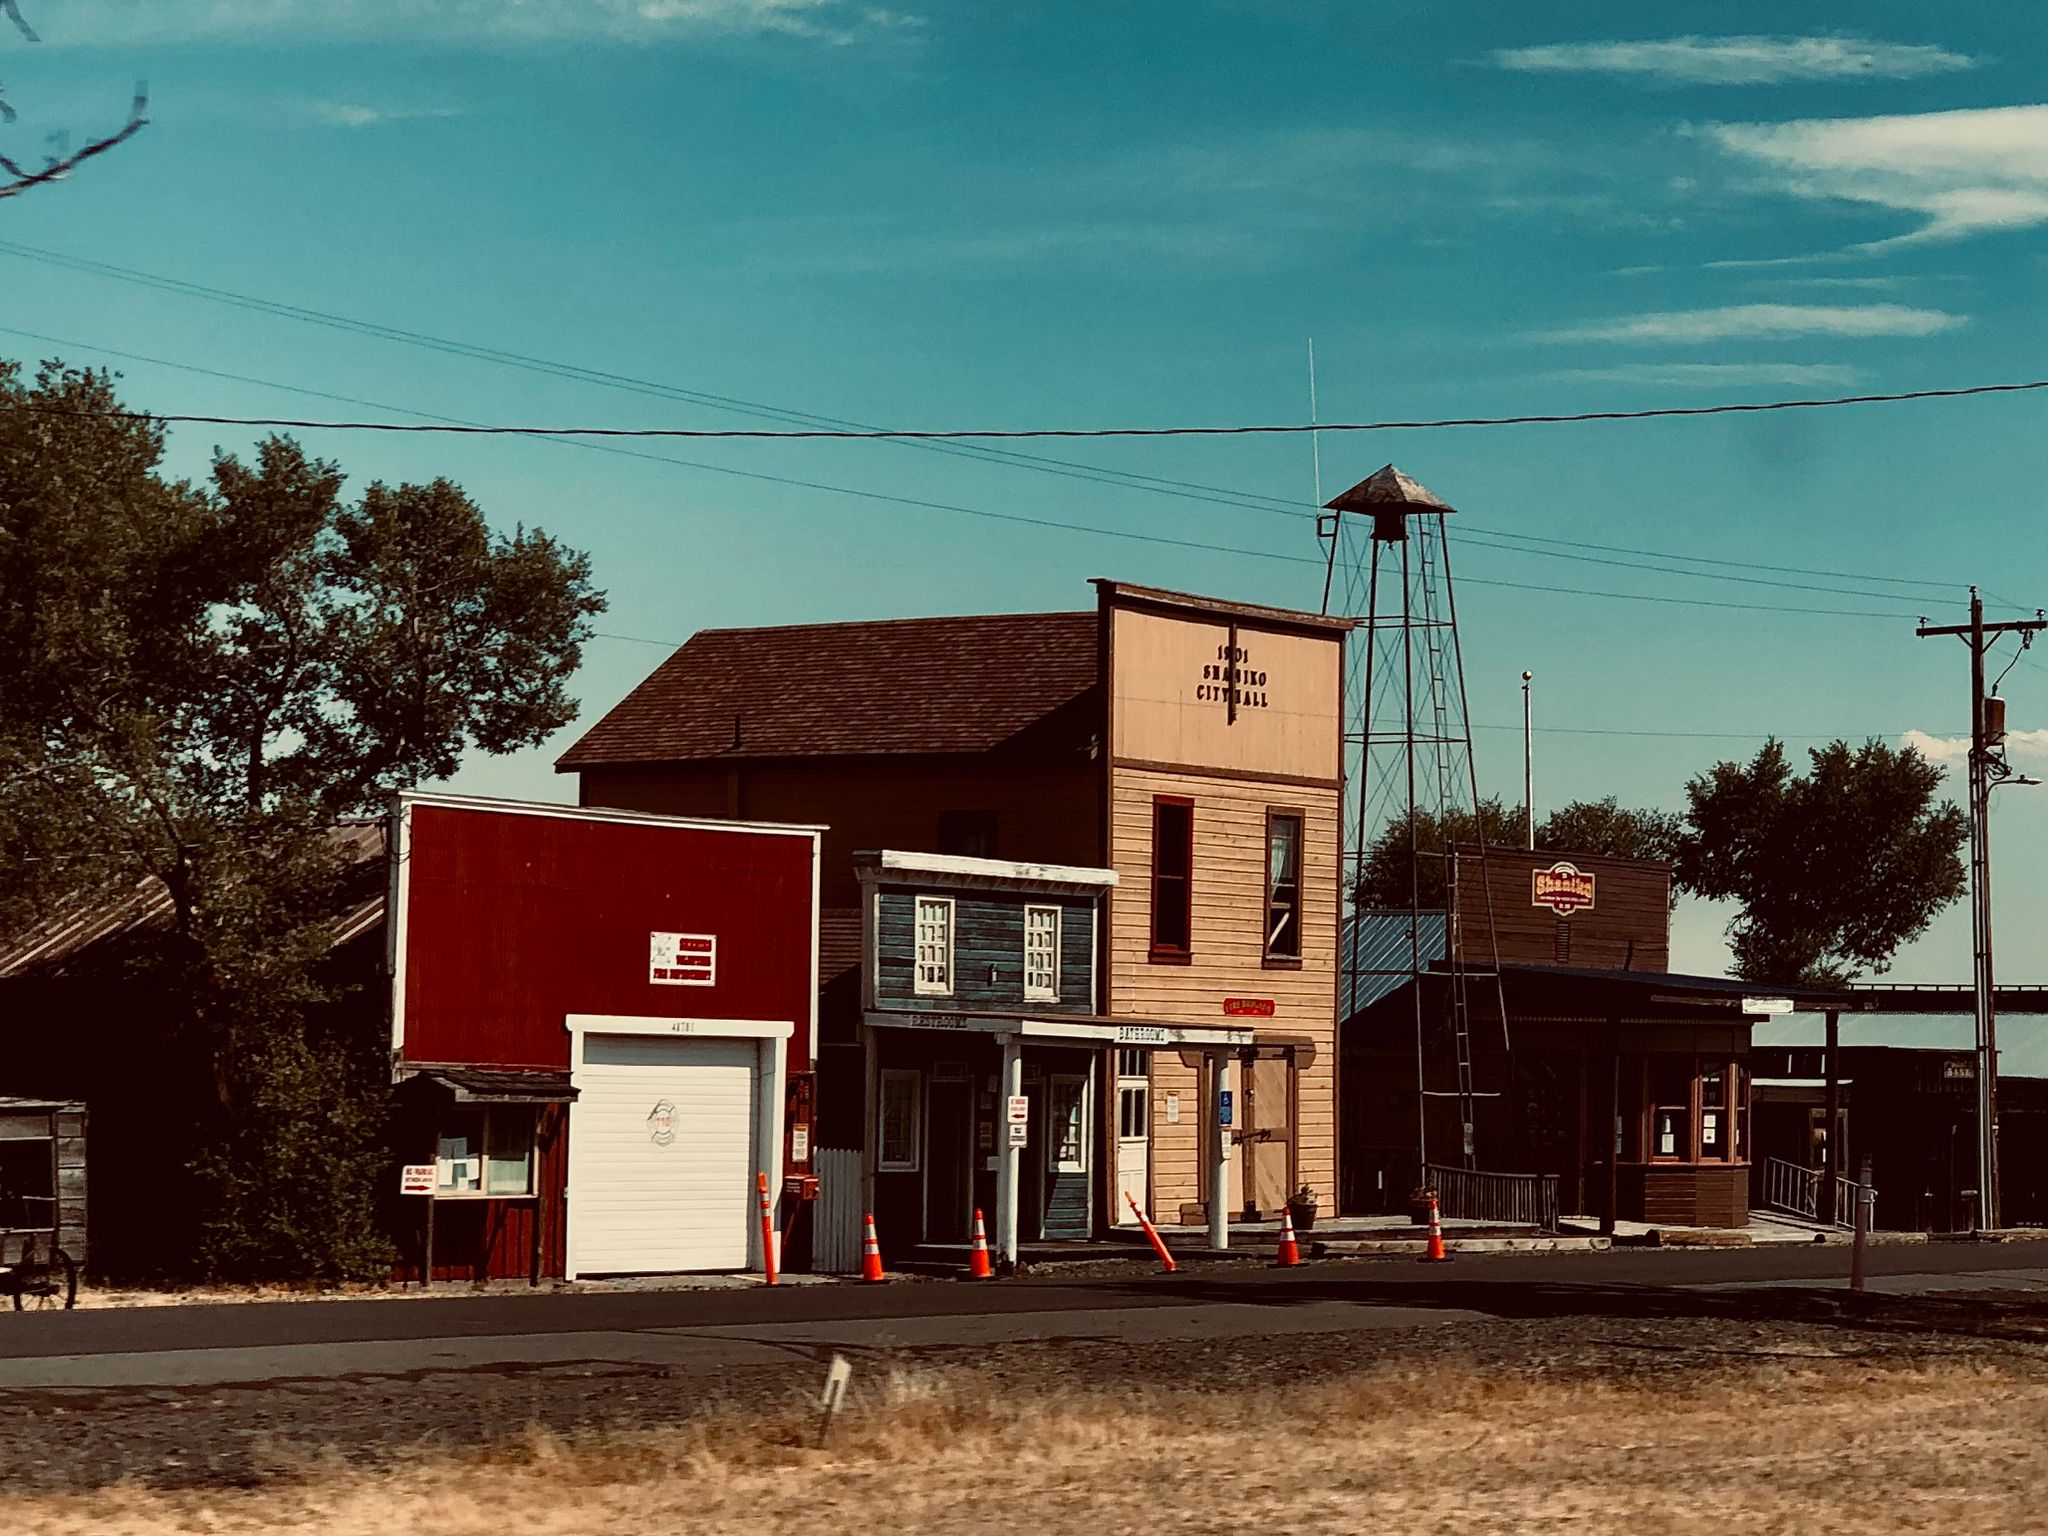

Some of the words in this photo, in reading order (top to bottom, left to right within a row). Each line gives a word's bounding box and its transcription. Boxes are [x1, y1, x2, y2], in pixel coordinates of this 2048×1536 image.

[1217, 644, 1249, 664] 1901
[1203, 664, 1267, 687] SHANIKO
[1196, 684, 1229, 703] CITY
[1234, 689, 1268, 708] HALL
